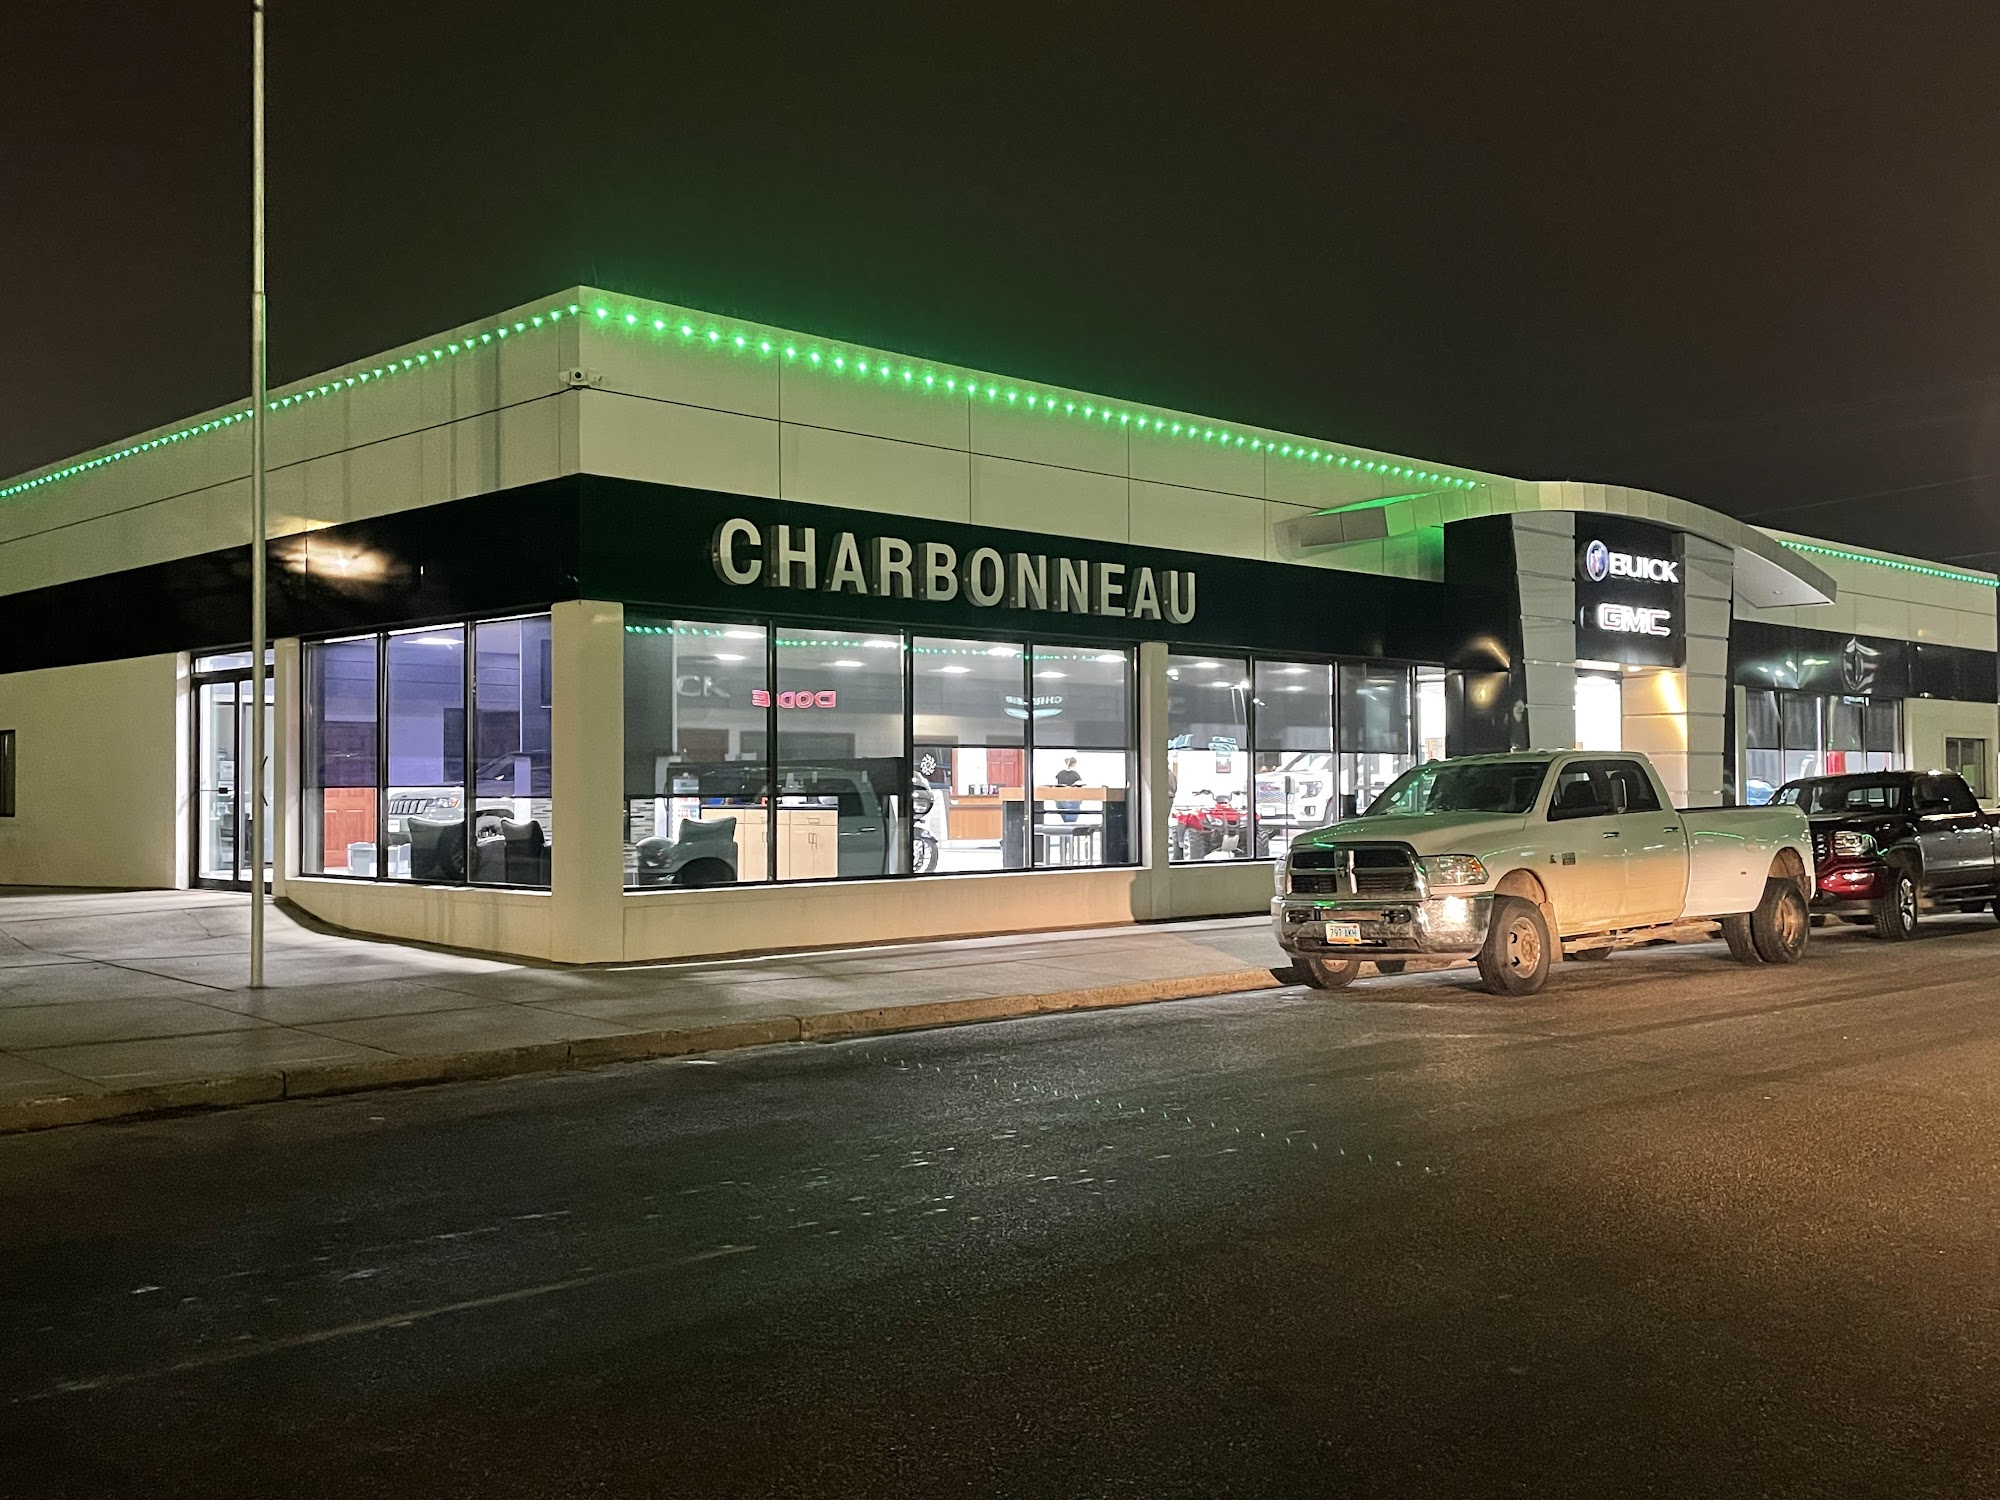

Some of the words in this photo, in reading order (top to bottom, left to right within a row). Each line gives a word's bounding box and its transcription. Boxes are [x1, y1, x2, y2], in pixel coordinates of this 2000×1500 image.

[715, 518, 1196, 624] CHARBONNEAU
[1609, 551, 1679, 583] BUICK
[1599, 603, 1671, 637] GMC
